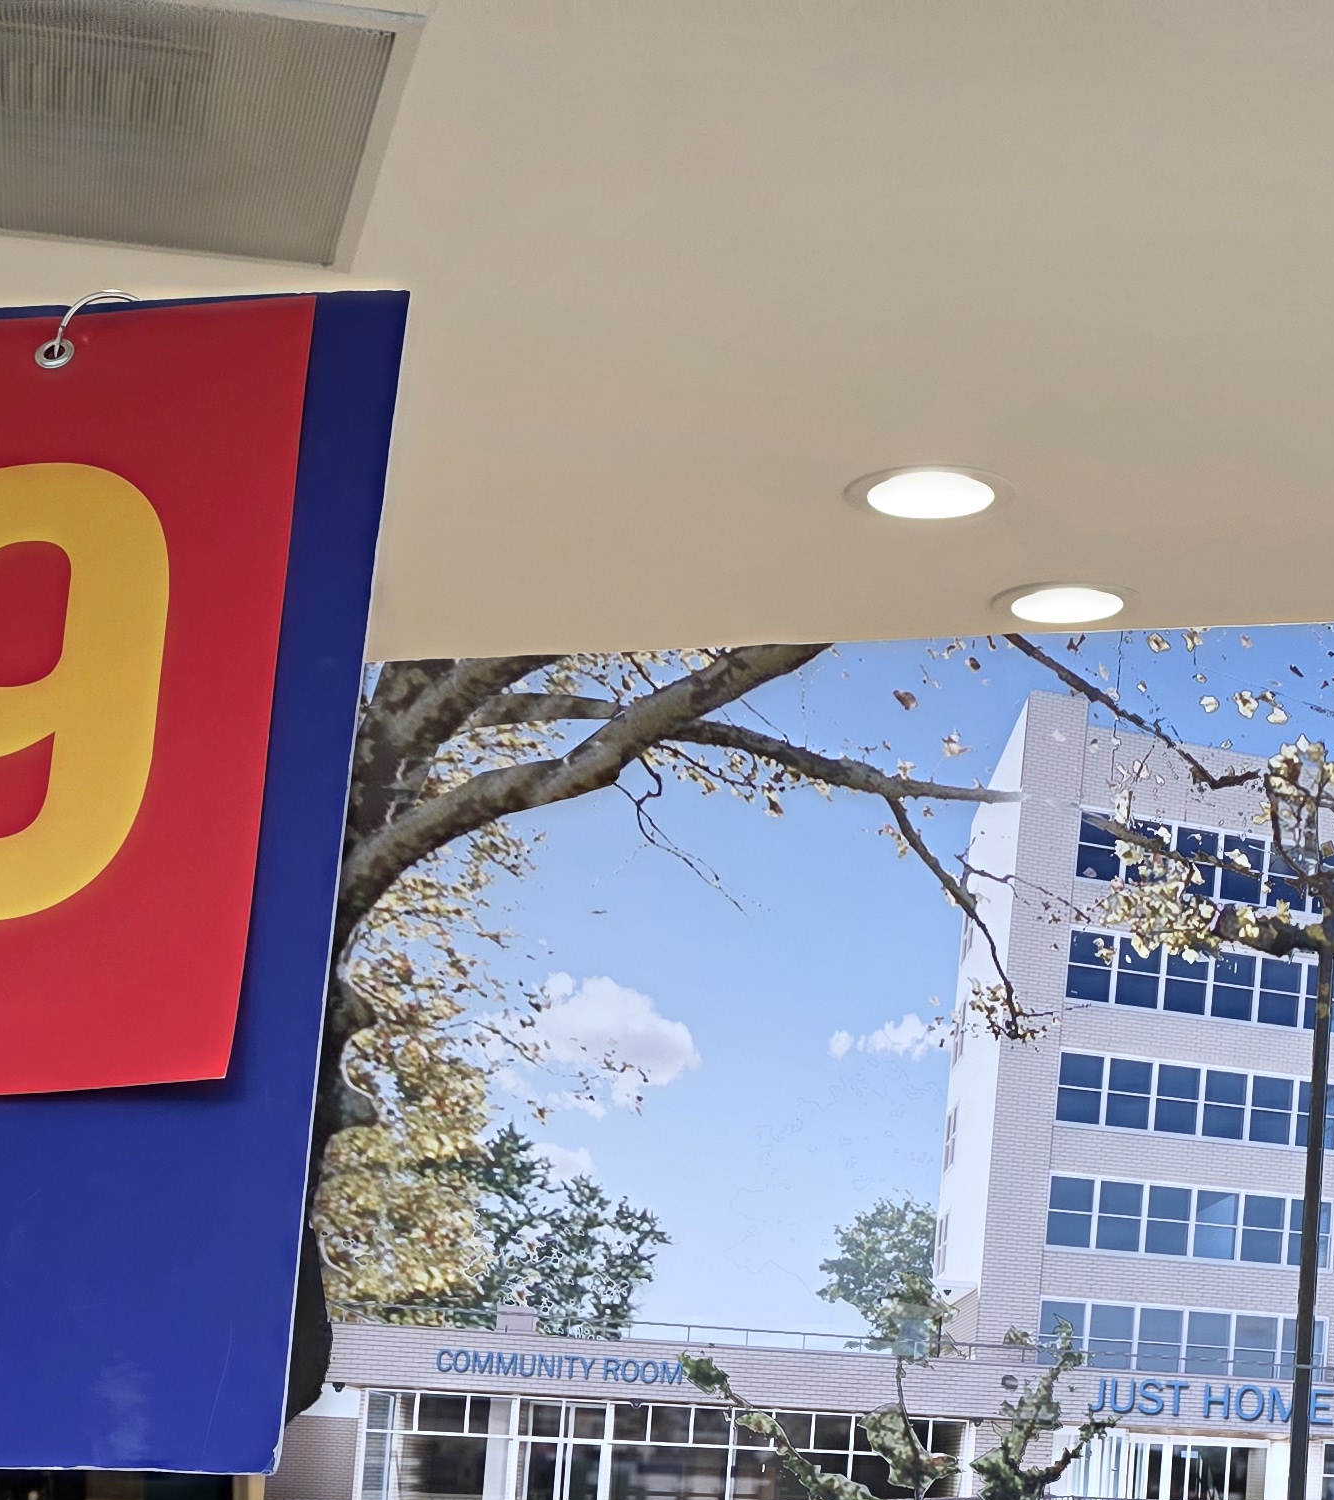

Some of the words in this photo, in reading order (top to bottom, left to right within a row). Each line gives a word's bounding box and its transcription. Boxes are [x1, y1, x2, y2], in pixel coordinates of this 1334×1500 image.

[435, 1348, 597, 1380] COMMUNITY
[602, 1357, 684, 1386] ROOM
[1088, 1377, 1189, 1417] JUST
[1203, 1383, 1334, 1425] HOME
